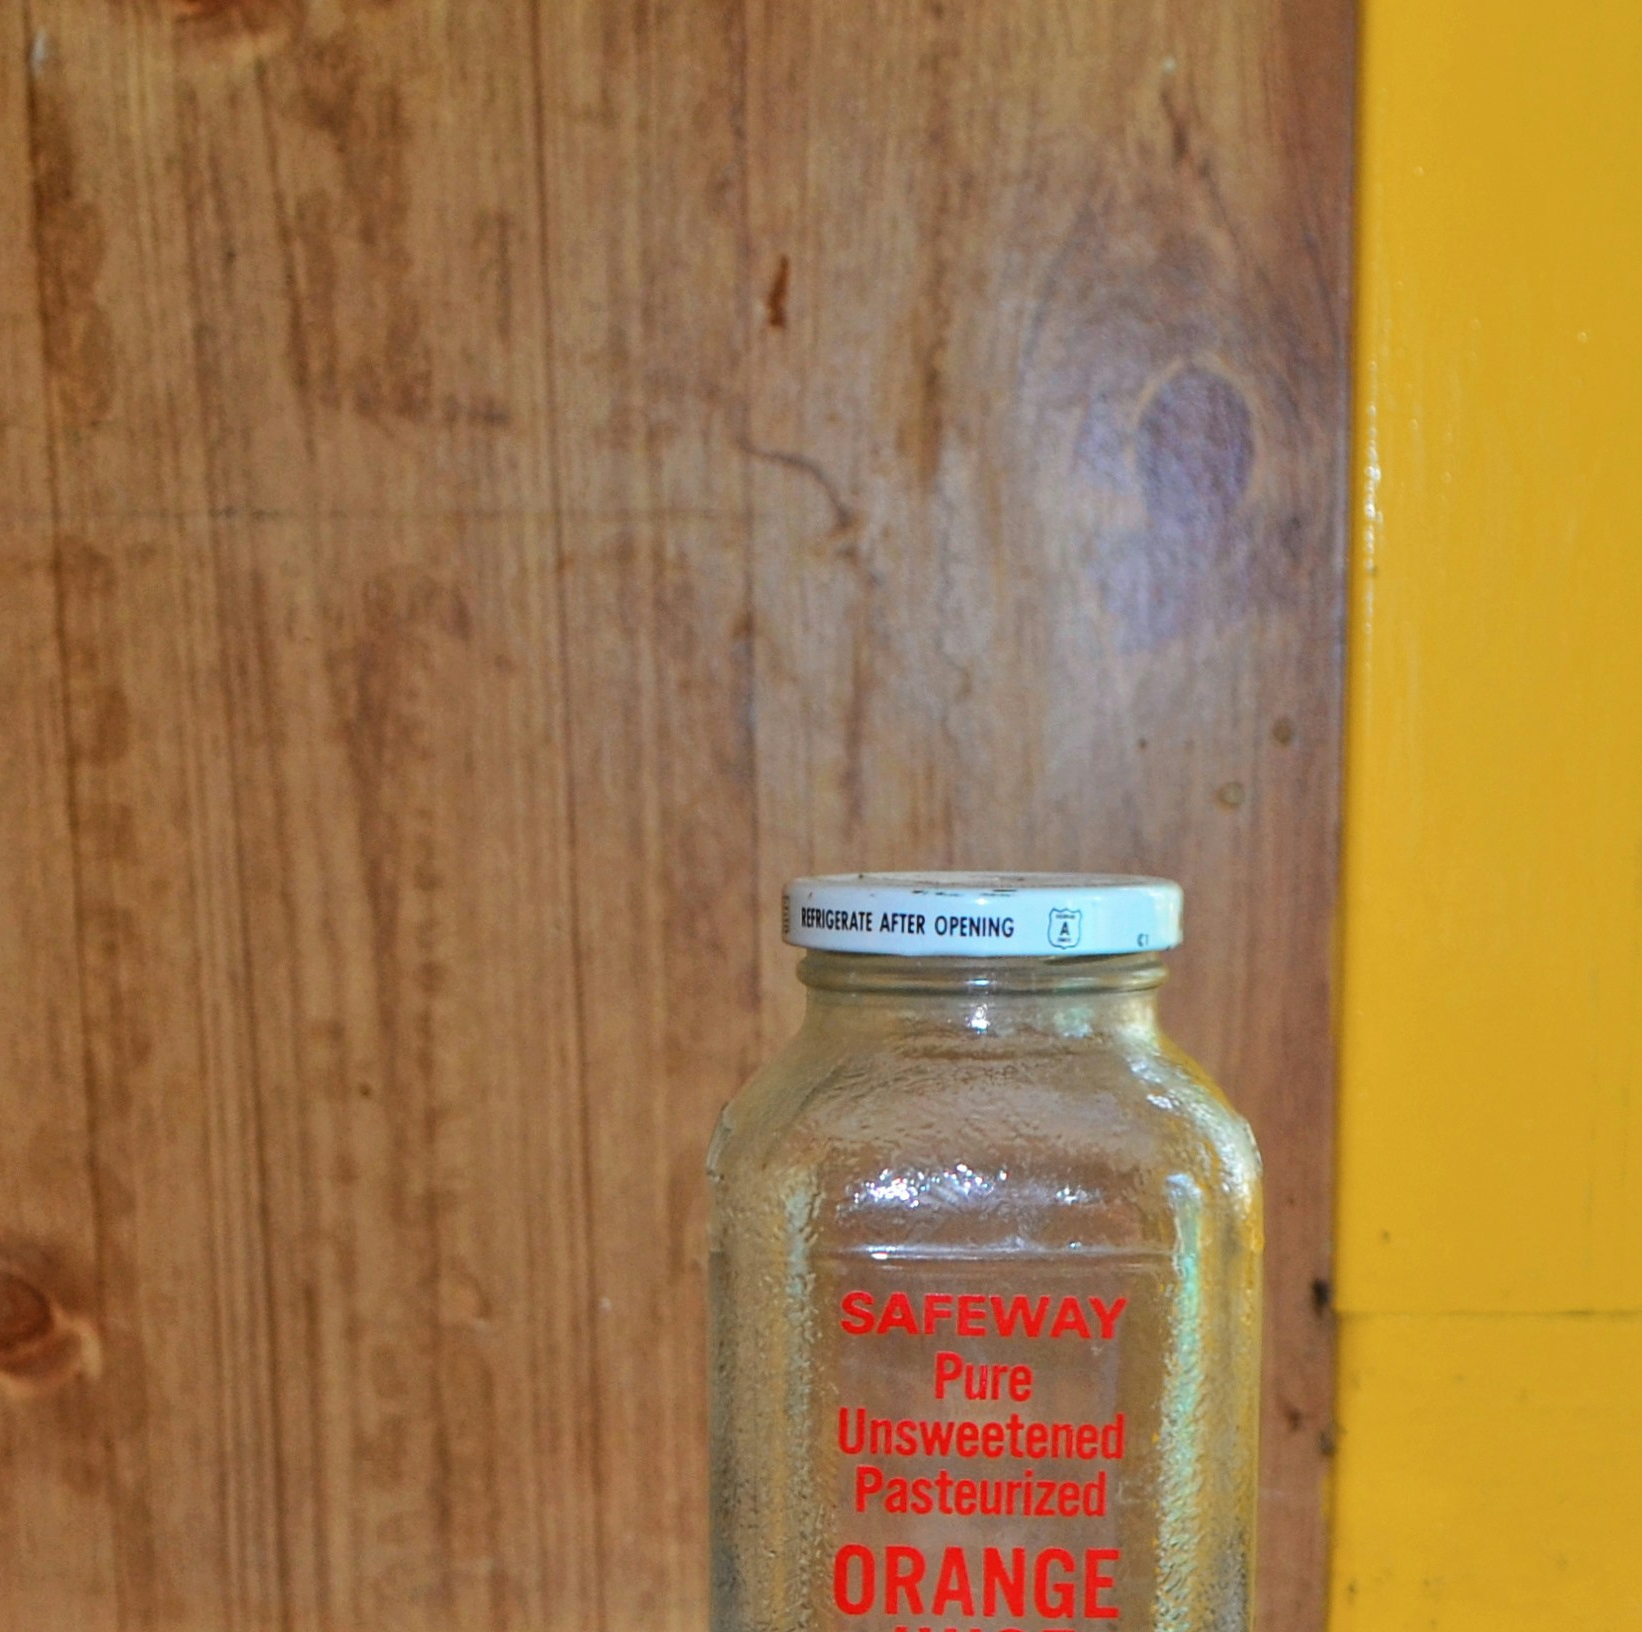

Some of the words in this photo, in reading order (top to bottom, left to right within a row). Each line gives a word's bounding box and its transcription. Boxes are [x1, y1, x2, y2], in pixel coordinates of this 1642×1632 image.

[801, 906, 873, 932] REFRIGERATE
[879, 911, 926, 935] AFTER
[934, 915, 1015, 938] OPENING
[839, 1290, 1129, 1341] SAFEWAY
[933, 1350, 1034, 1403] Pure
[837, 1406, 1126, 1460] Unsweetened
[854, 1464, 1108, 1518] Pasteurized
[832, 1542, 1122, 1620] ORANGE
